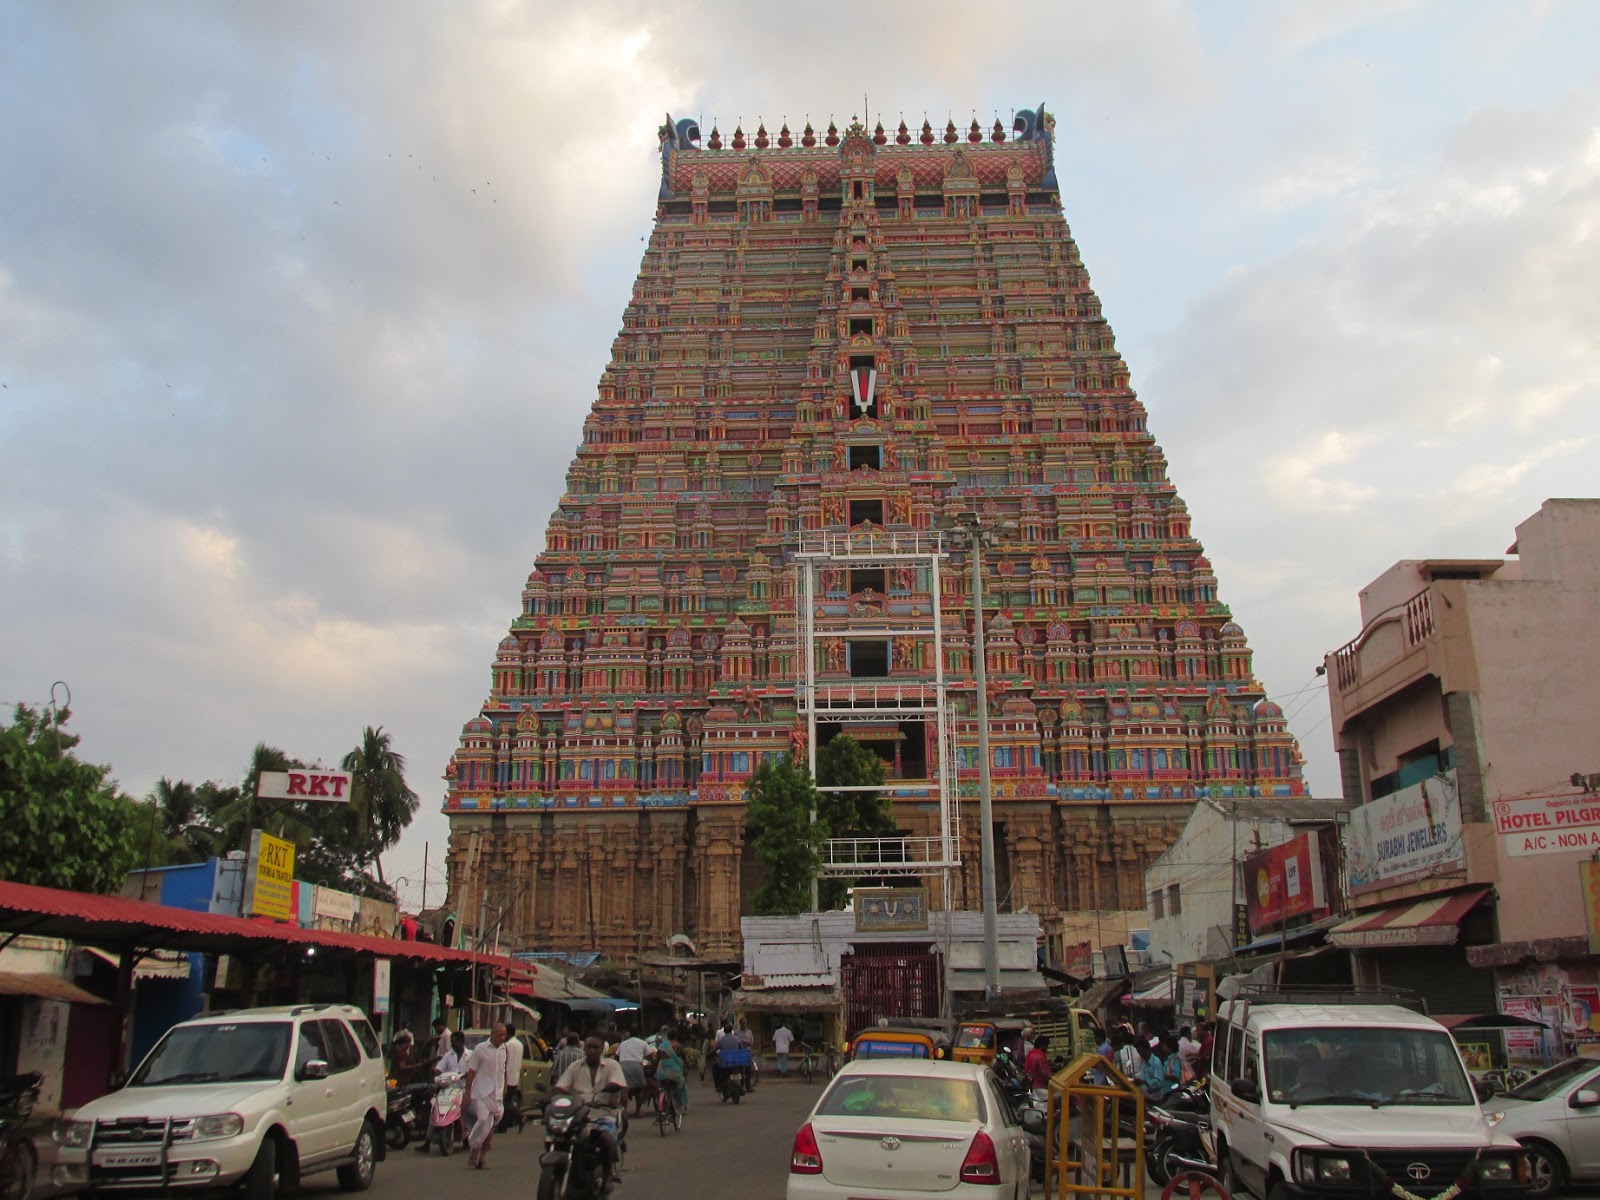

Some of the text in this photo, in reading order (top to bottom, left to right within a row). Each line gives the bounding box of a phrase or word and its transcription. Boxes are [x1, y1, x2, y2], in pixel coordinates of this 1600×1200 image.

[287, 773, 348, 797] RKT
[1500, 812, 1552, 831] HOTEL
[1376, 834, 1406, 861] SURABHI
[1407, 821, 1447, 853] JEWELLERS
[1524, 836, 1547, 850] A/C
[1558, 833, 1587, 847] NON
[266, 842, 288, 868] RKT
[258, 864, 272, 878] TOURS
[1365, 928, 1418, 945] JEWELLERS
